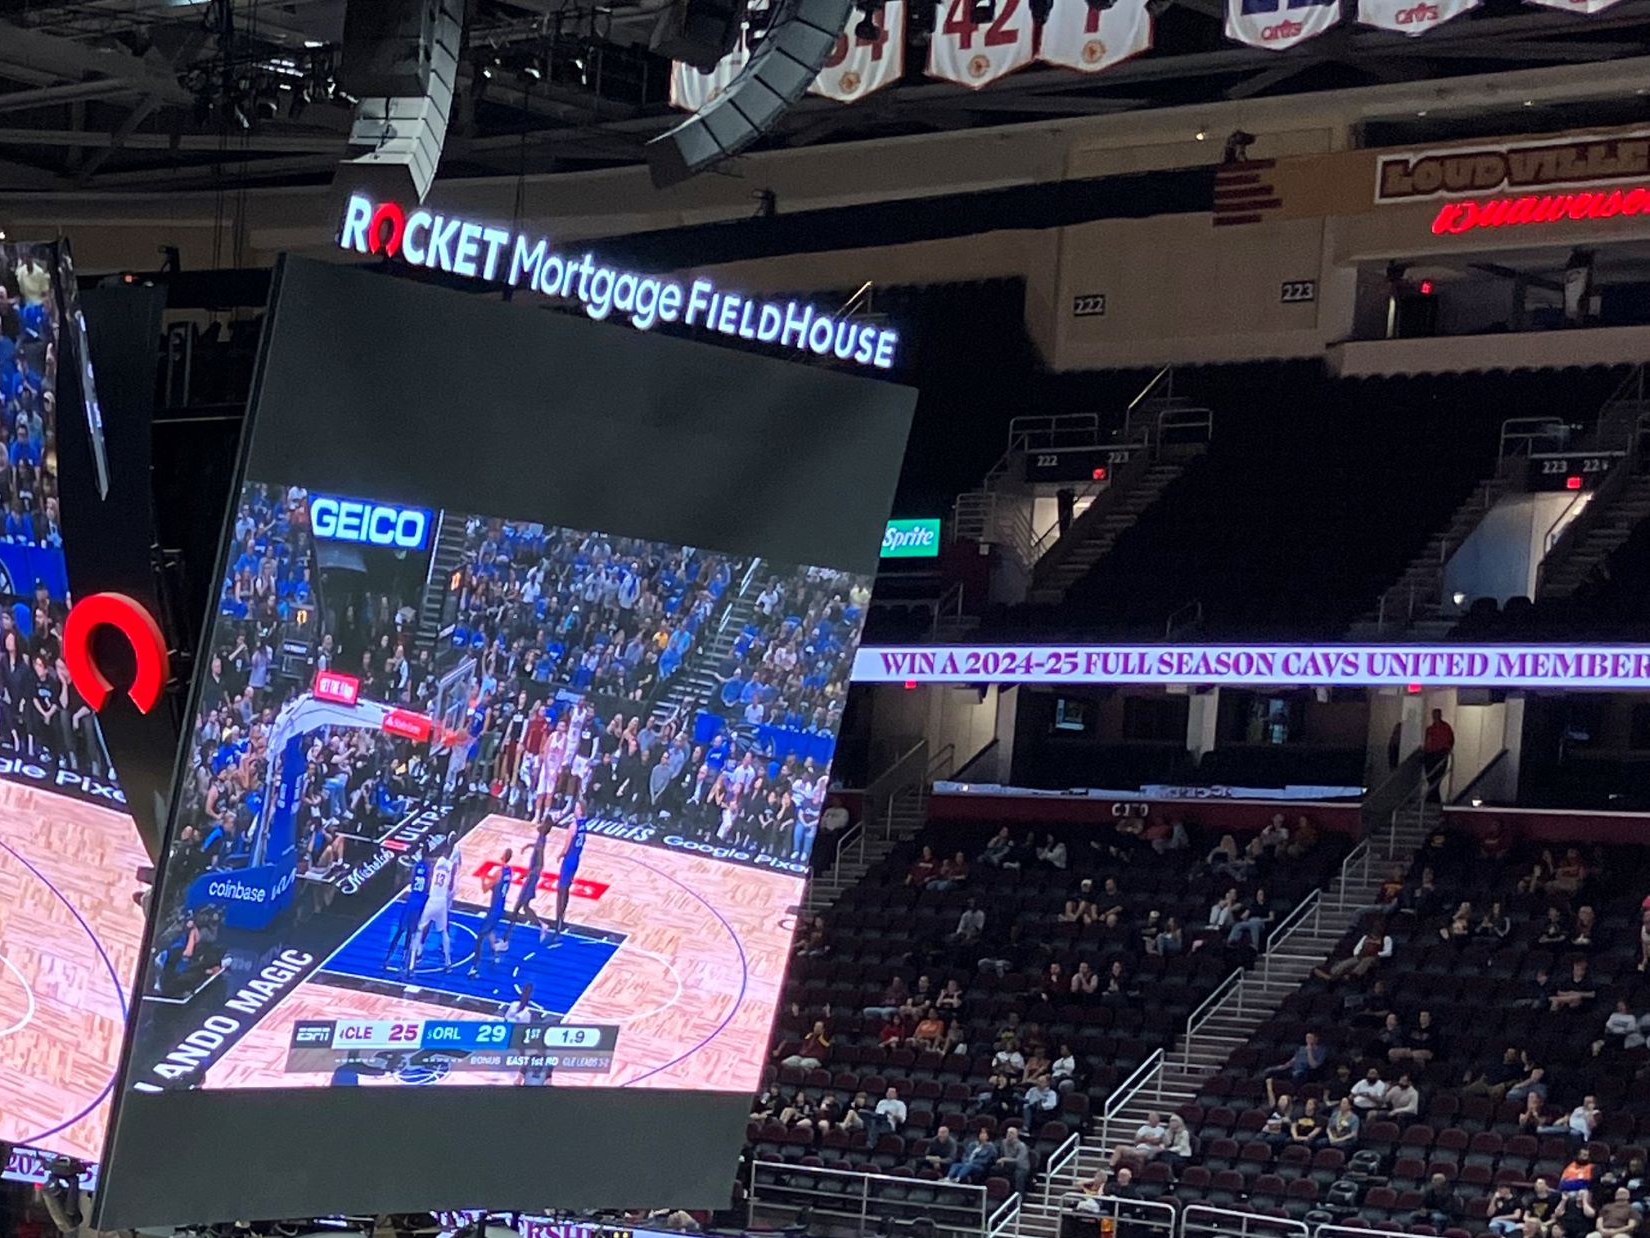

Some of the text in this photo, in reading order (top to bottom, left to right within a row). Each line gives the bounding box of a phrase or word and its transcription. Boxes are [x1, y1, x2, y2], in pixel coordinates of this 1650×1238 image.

[340, 195, 509, 282] ROCKET
[509, 234, 684, 330] Mortgage
[311, 498, 425, 546] GEICO
[881, 525, 936, 552] Sprite
[880, 652, 936, 676] WIN
[941, 653, 962, 676] A
[964, 650, 1081, 678] 2024-25
[1084, 652, 1154, 677] FULL
[1157, 652, 1277, 677] SEASON
[1281, 653, 1360, 677] CAVS
[1366, 653, 1489, 678] UNITED
[663, 834, 750, 861] Google
[209, 879, 266, 902] coinbase
[225, 948, 314, 1015] MAGIC
[296, 1027, 331, 1041] ESPN
[344, 1026, 372, 1040] CLE
[388, 1023, 419, 1042] 25
[432, 1025, 462, 1040] ORL
[476, 1024, 507, 1043] 29
[560, 1030, 585, 1044] 1.9
[506, 1055, 530, 1066] EAST
